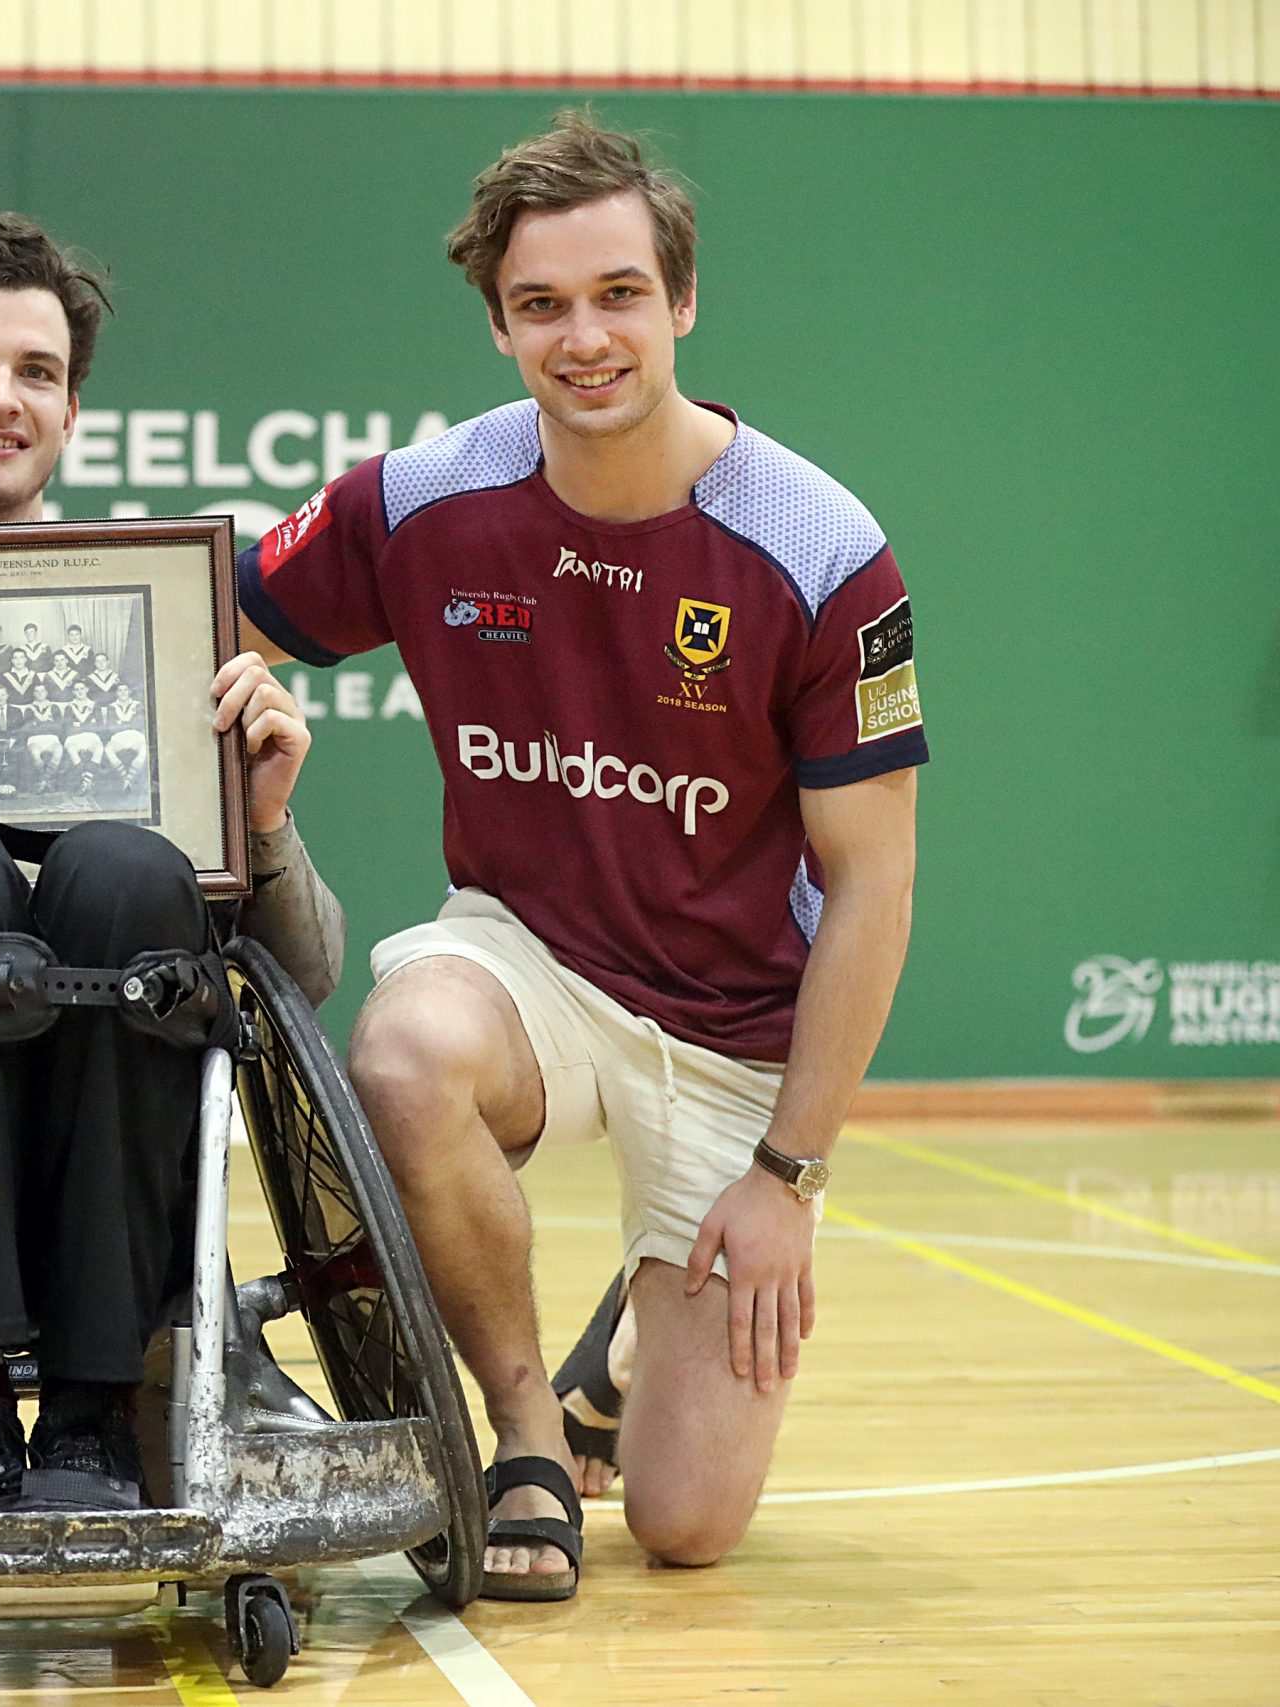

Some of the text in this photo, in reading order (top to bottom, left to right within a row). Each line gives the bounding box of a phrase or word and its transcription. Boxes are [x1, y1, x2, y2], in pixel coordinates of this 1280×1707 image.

[451, 588, 490, 601] University
[474, 602, 531, 629] RED
[486, 631, 527, 641] HEAVIES
[678, 682, 708, 700] XV
[868, 682, 887, 702] UQ
[657, 695, 727, 713] 2018 SEASON
